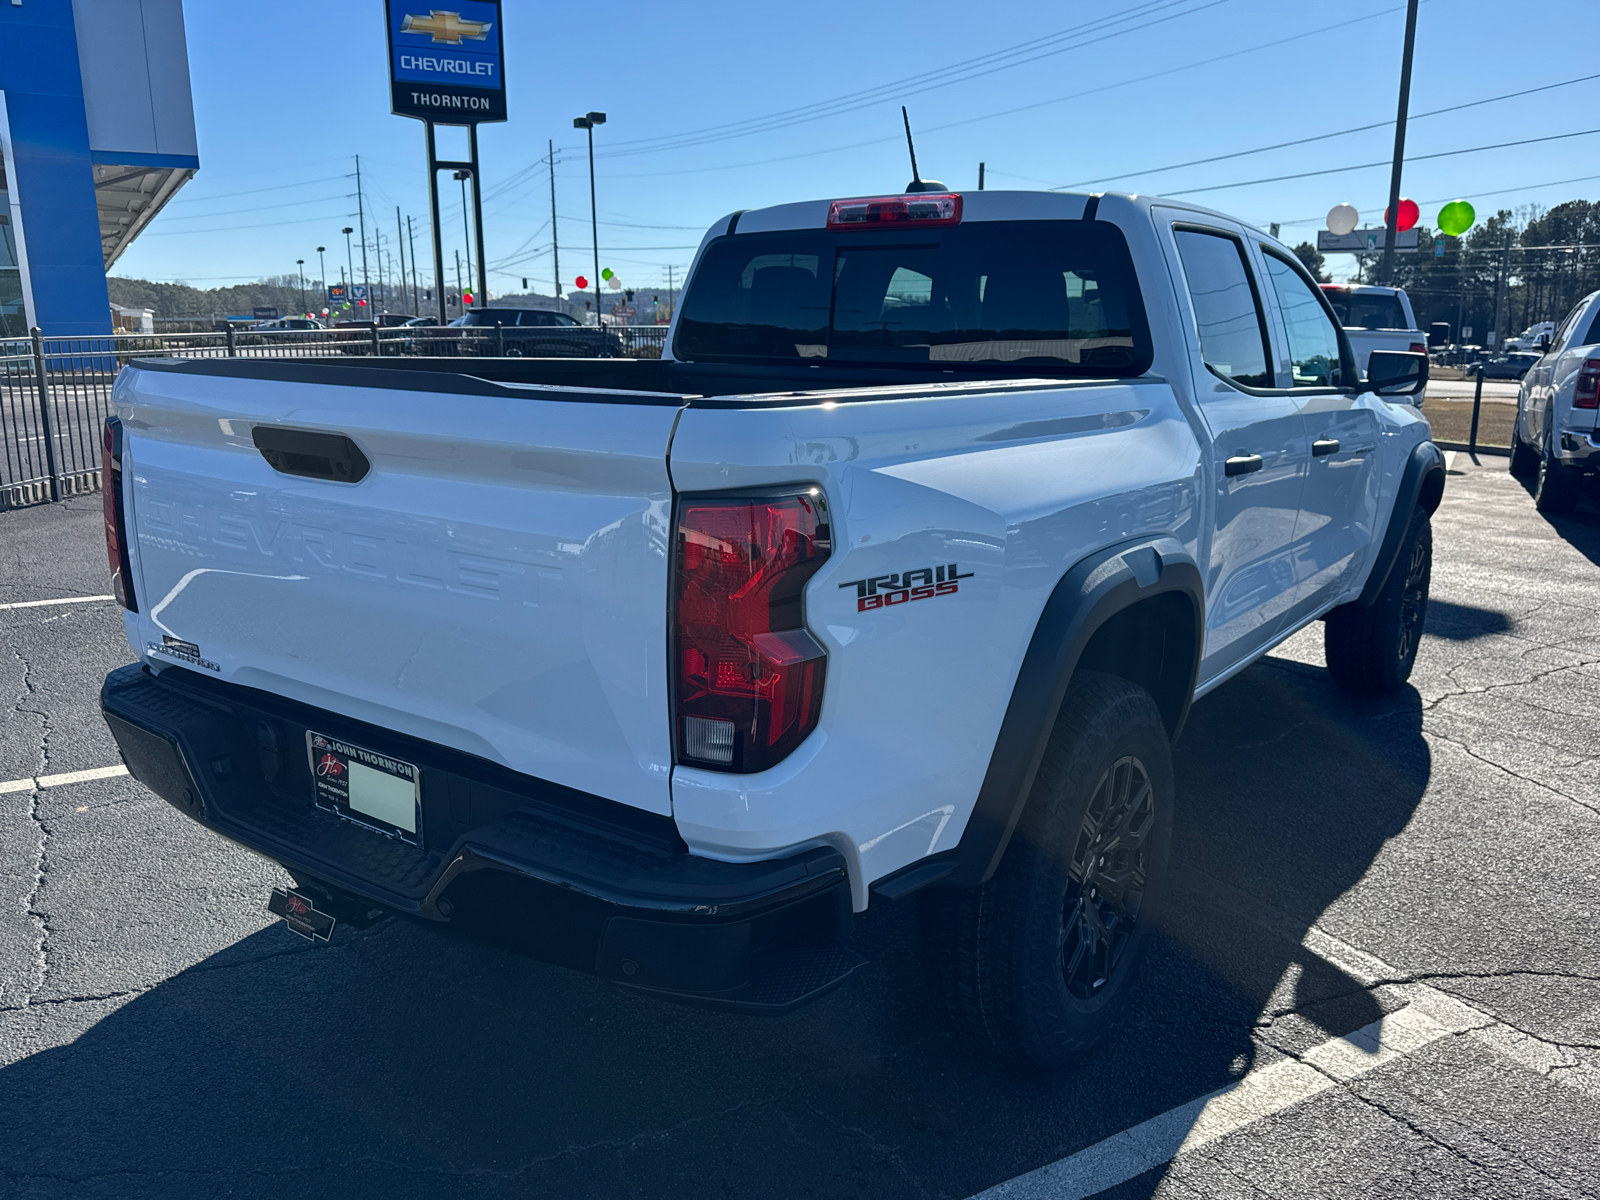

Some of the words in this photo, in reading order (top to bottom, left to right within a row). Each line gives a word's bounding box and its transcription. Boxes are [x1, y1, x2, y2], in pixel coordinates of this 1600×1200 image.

[400, 55, 495, 76] CHEVROLET
[411, 92, 490, 109] THORNTON
[143, 498, 563, 608] CHEVROLET
[838, 562, 975, 598] TRAIL
[857, 580, 958, 613] BOSS
[331, 741, 357, 758] JOHN
[357, 750, 412, 777] THORNTON
